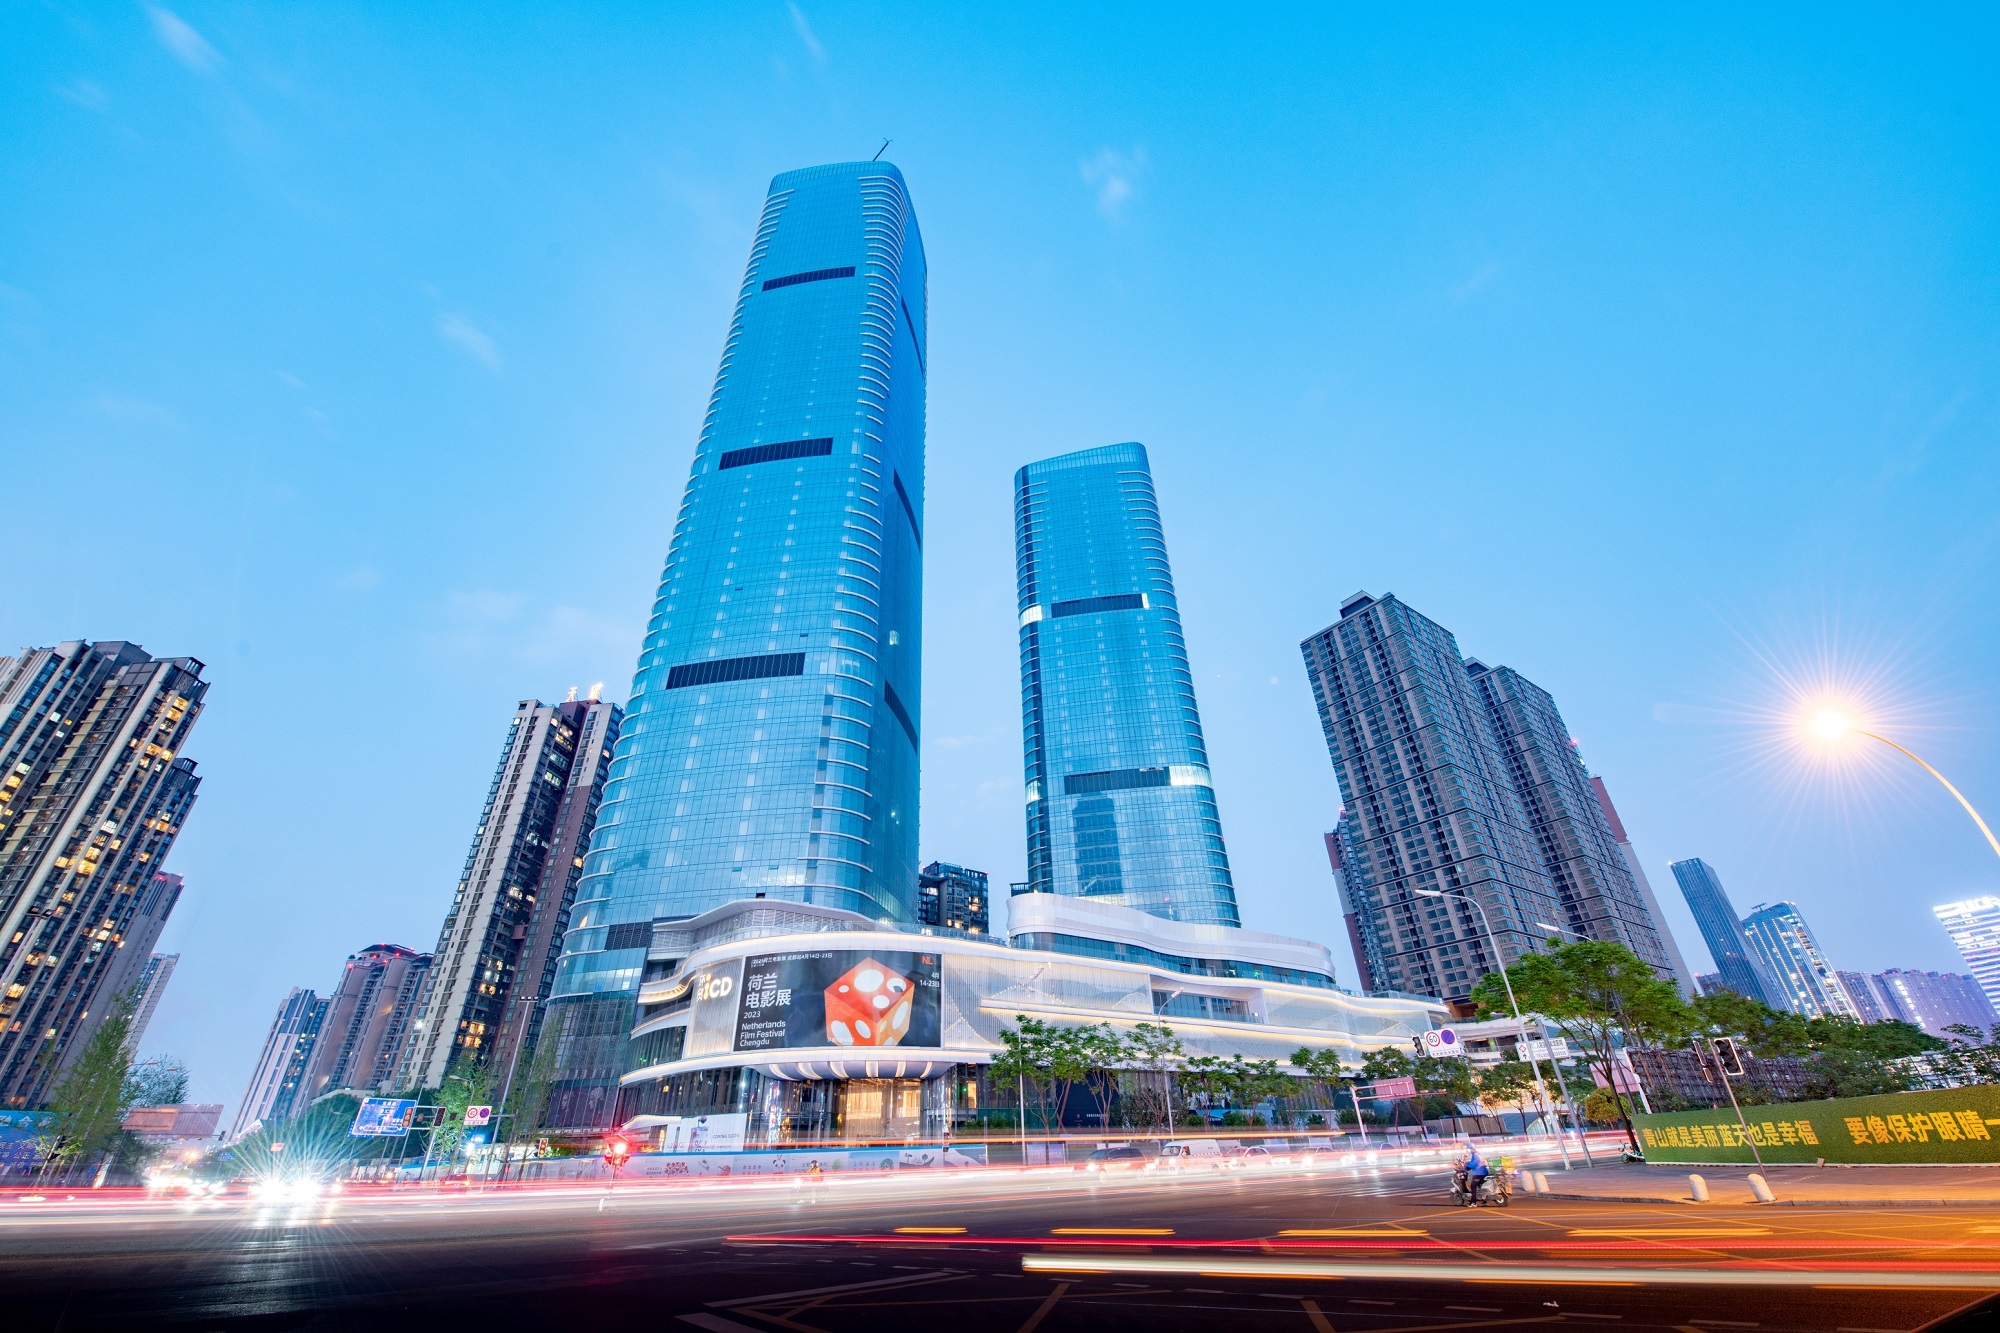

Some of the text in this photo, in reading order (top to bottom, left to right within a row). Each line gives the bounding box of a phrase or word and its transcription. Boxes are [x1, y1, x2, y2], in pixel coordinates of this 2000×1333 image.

[748, 972, 778, 991] 荷兰
[745, 988, 792, 1009] 电影展
[743, 1010, 761, 1019] 2023
[741, 1020, 786, 1030] Netherlands
[740, 1028, 785, 1040] Film Festival
[1429, 1035, 1437, 1043] 60
[739, 1038, 770, 1048] Chengdu
[1843, 1109, 2000, 1145] 要像保护眼睛一
